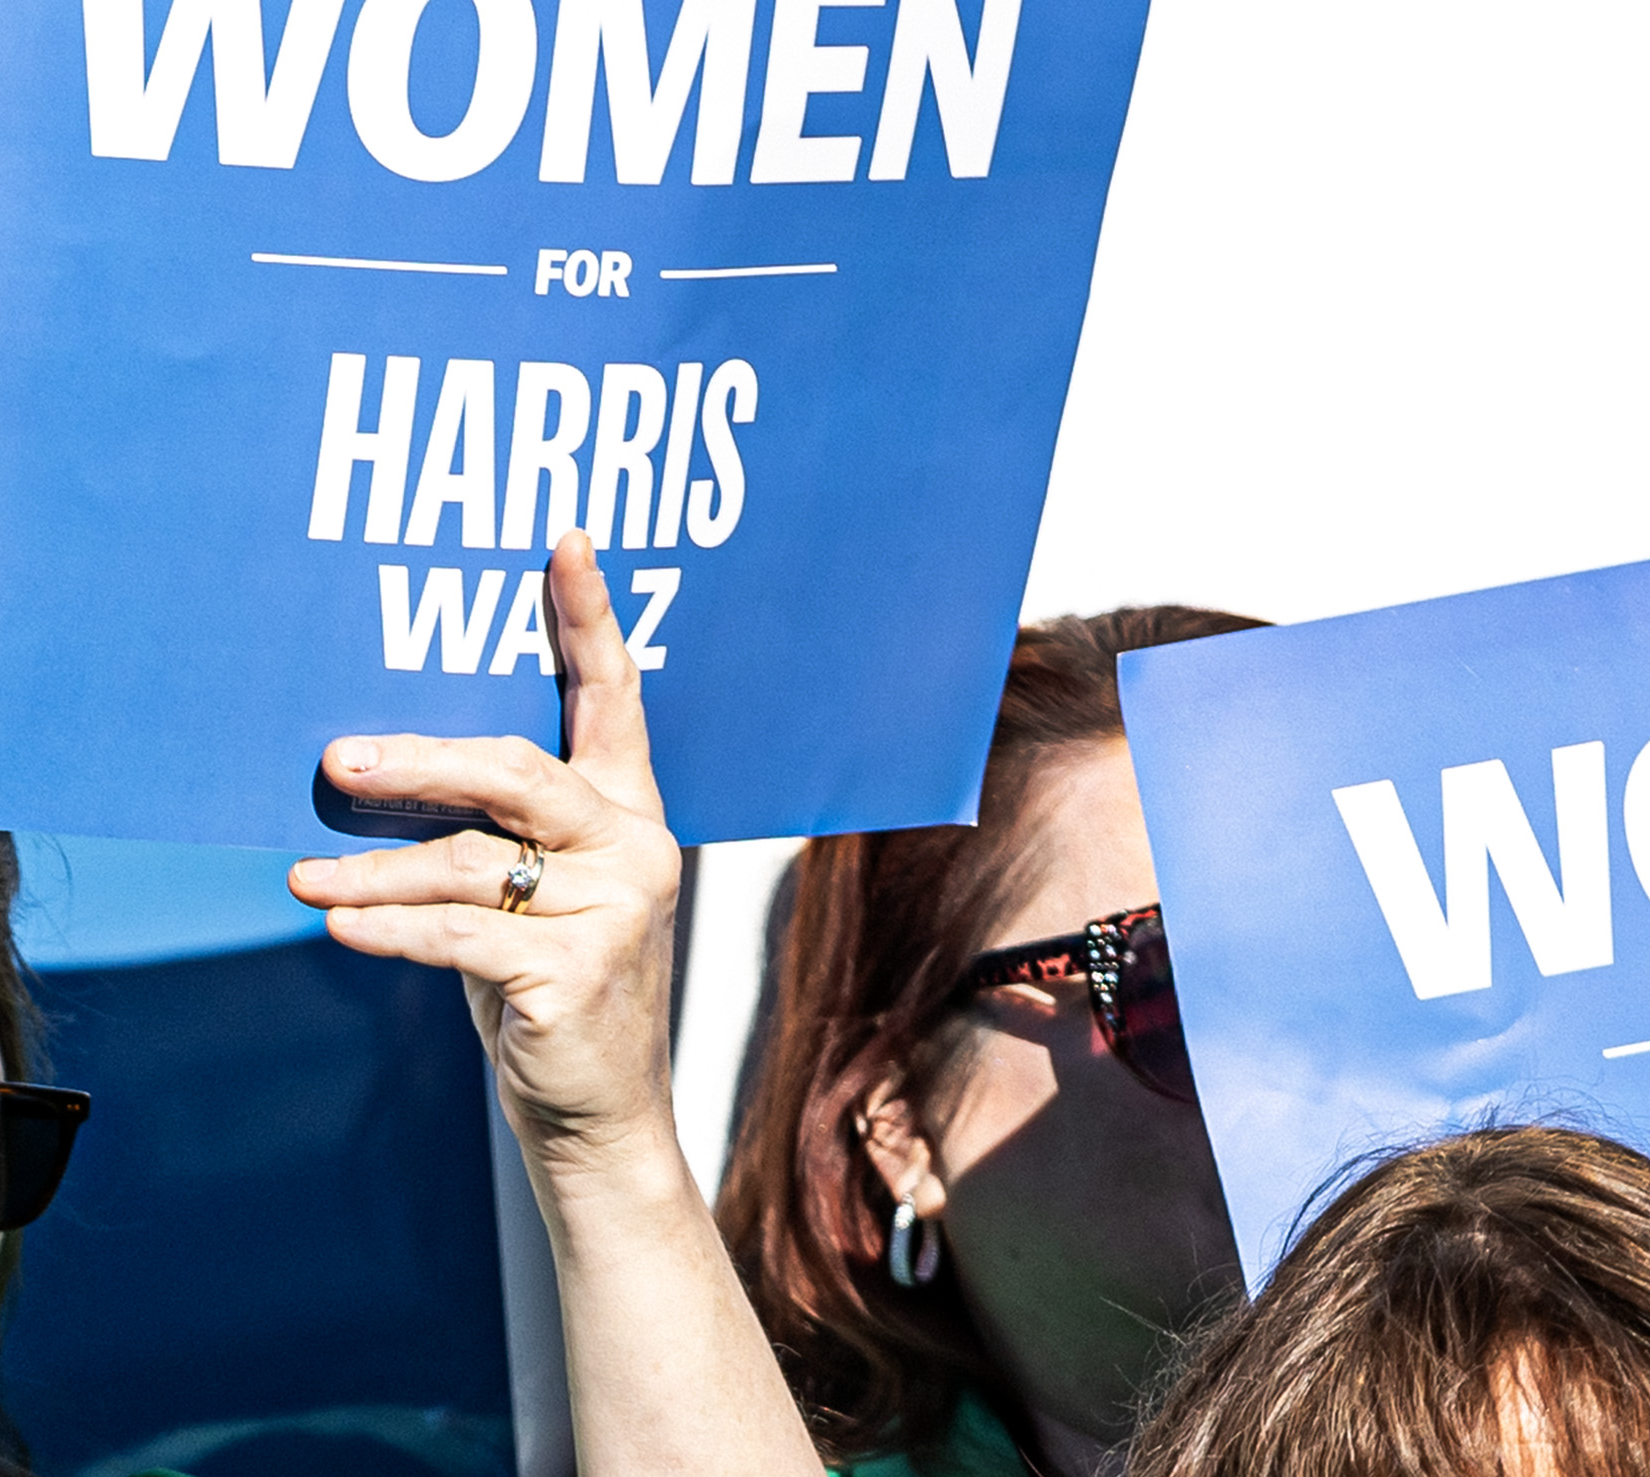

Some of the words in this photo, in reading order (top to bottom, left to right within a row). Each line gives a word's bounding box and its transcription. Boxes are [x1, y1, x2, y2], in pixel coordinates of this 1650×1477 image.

[83, 0, 1021, 184] WOMEN
[535, 249, 632, 297] FOR
[308, 353, 758, 550] HARRIS
[379, 565, 681, 676] WAZ
